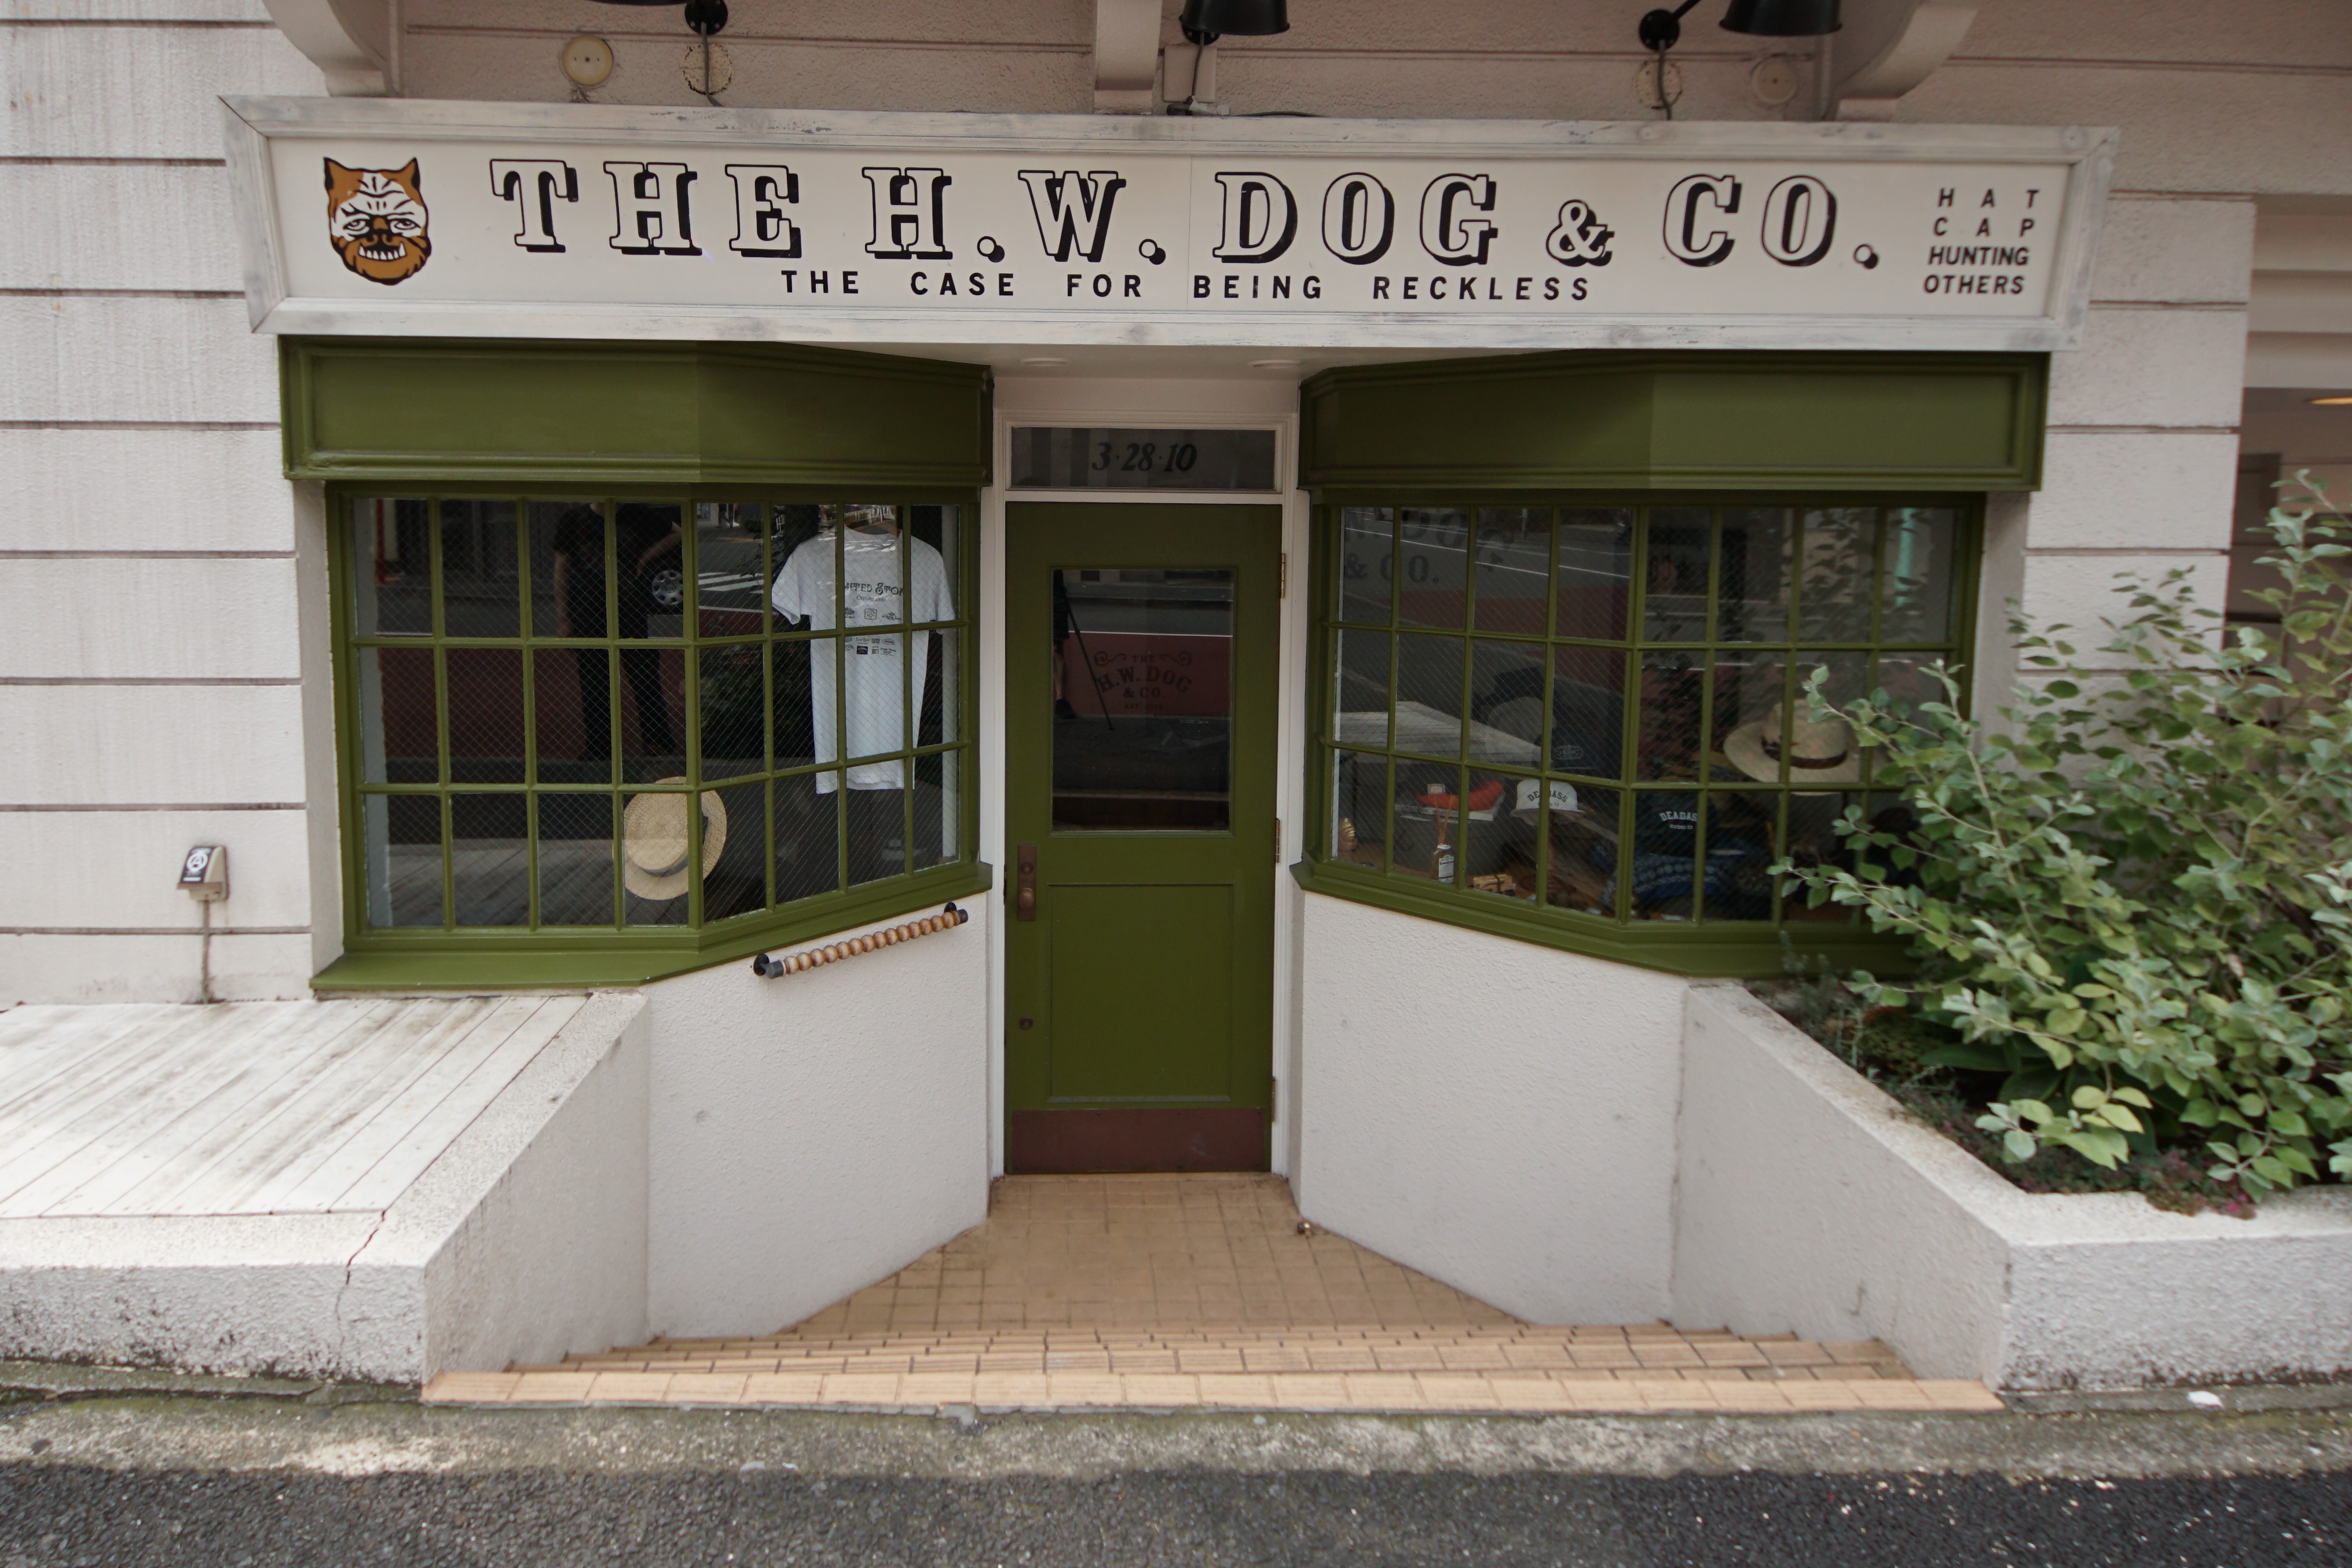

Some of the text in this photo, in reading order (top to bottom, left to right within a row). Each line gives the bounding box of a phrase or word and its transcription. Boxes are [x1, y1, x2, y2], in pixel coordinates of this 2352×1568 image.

[490, 159, 1880, 270] THE H.W. DOG & CO.
[1928, 246, 2031, 266] HUNTING
[781, 270, 1588, 302] THE CASE FOR BEING RECKLESS
[1923, 274, 2025, 295] OTHERS
[1097, 666, 1193, 693] H.W. DOG
[1123, 687, 1166, 698] & CO.
[1527, 790, 1568, 803] DEASS
